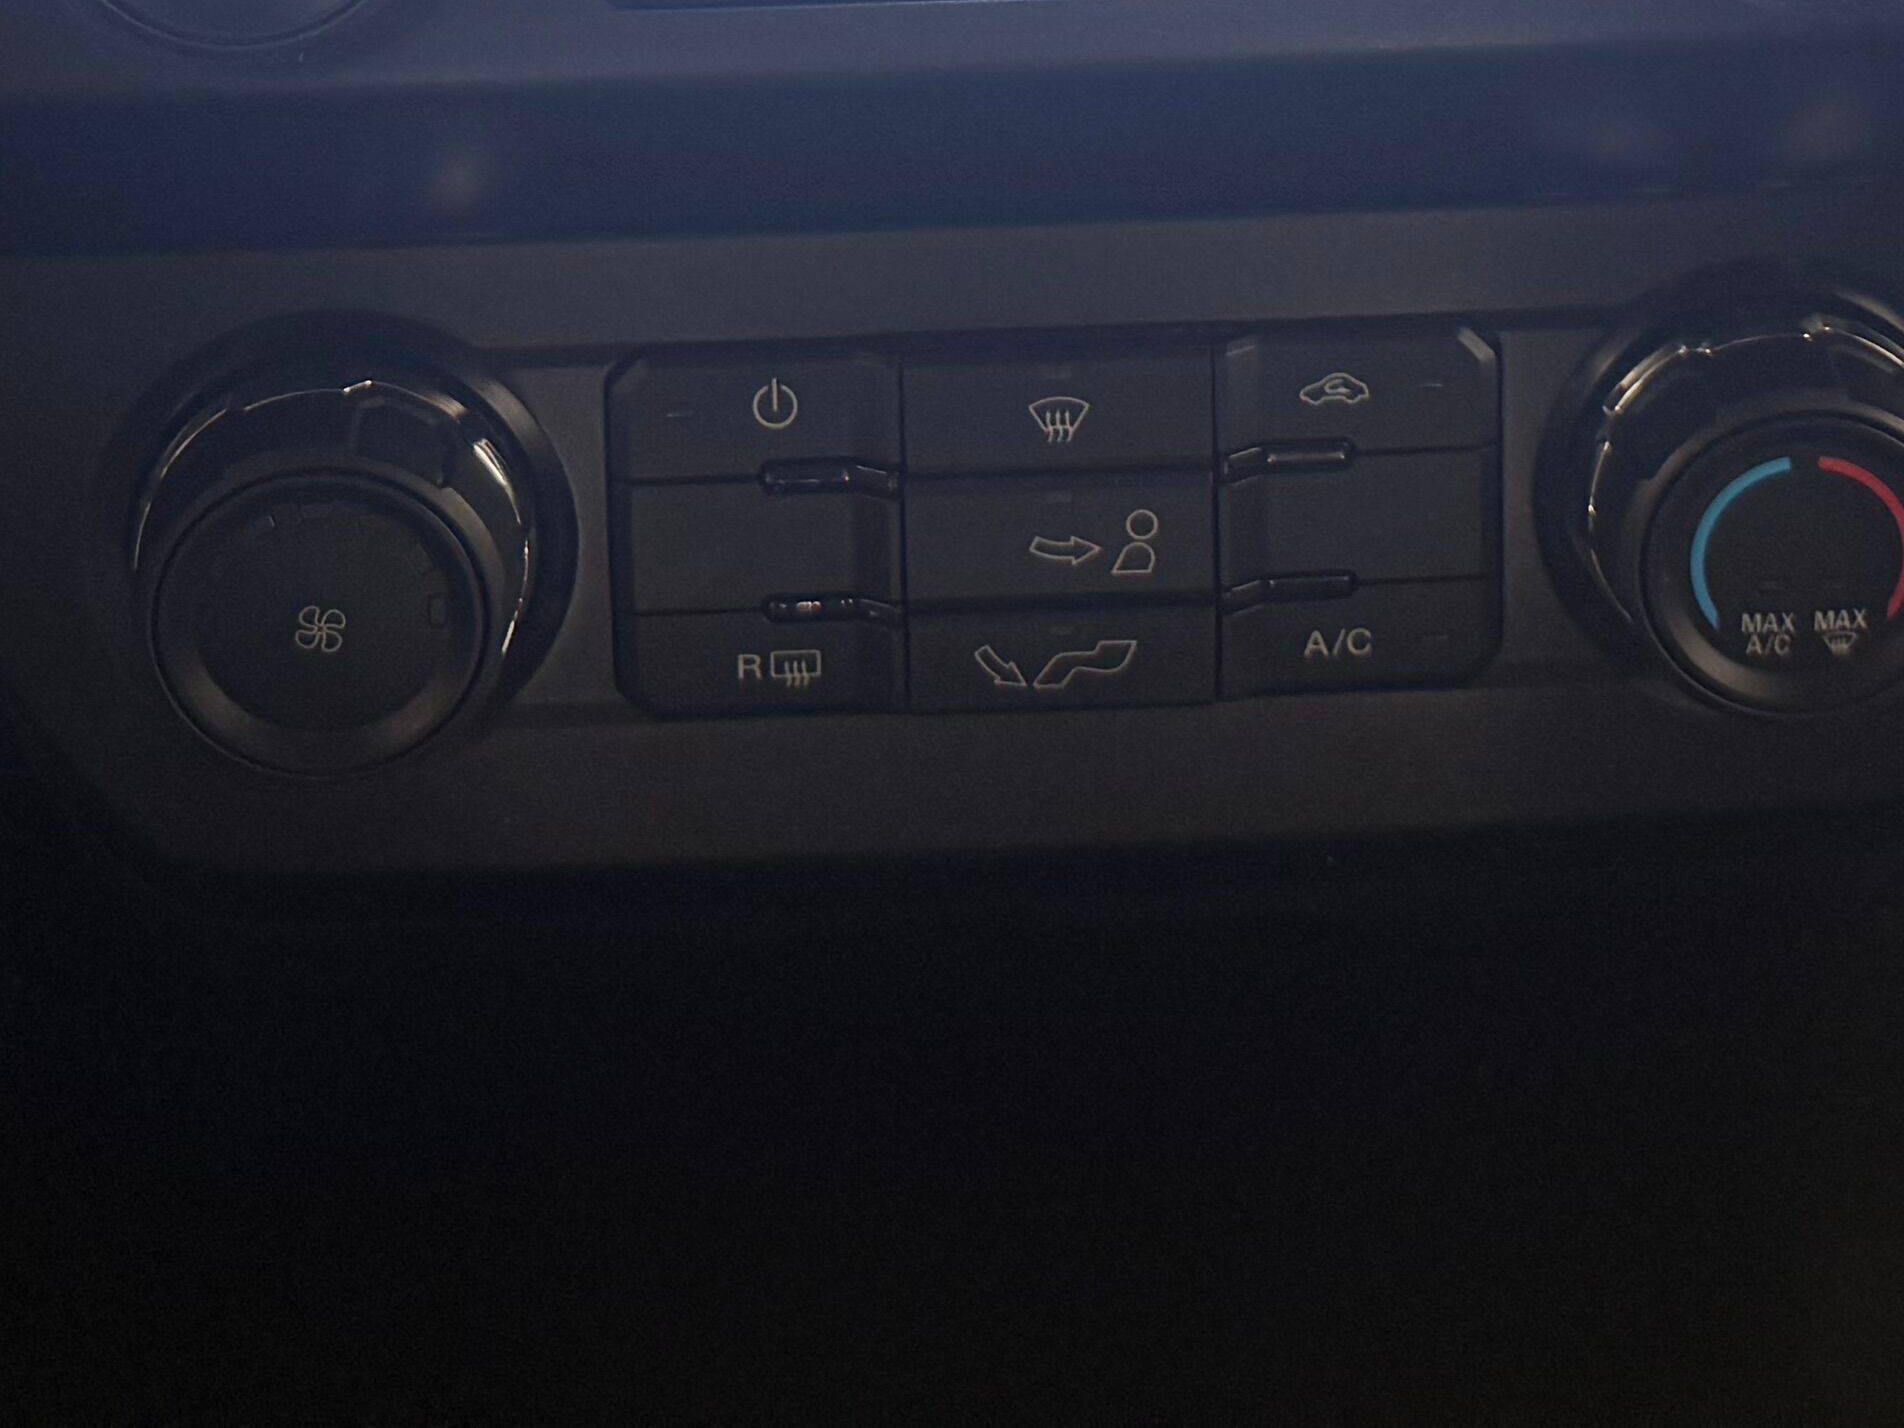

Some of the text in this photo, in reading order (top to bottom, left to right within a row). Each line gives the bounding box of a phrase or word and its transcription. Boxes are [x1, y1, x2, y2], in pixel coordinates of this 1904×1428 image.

[1741, 611, 1795, 633] MAX
[1813, 608, 1868, 632] MAX
[1302, 626, 1375, 660] A/C
[1746, 634, 1792, 656] A/C
[737, 653, 763, 681] R
